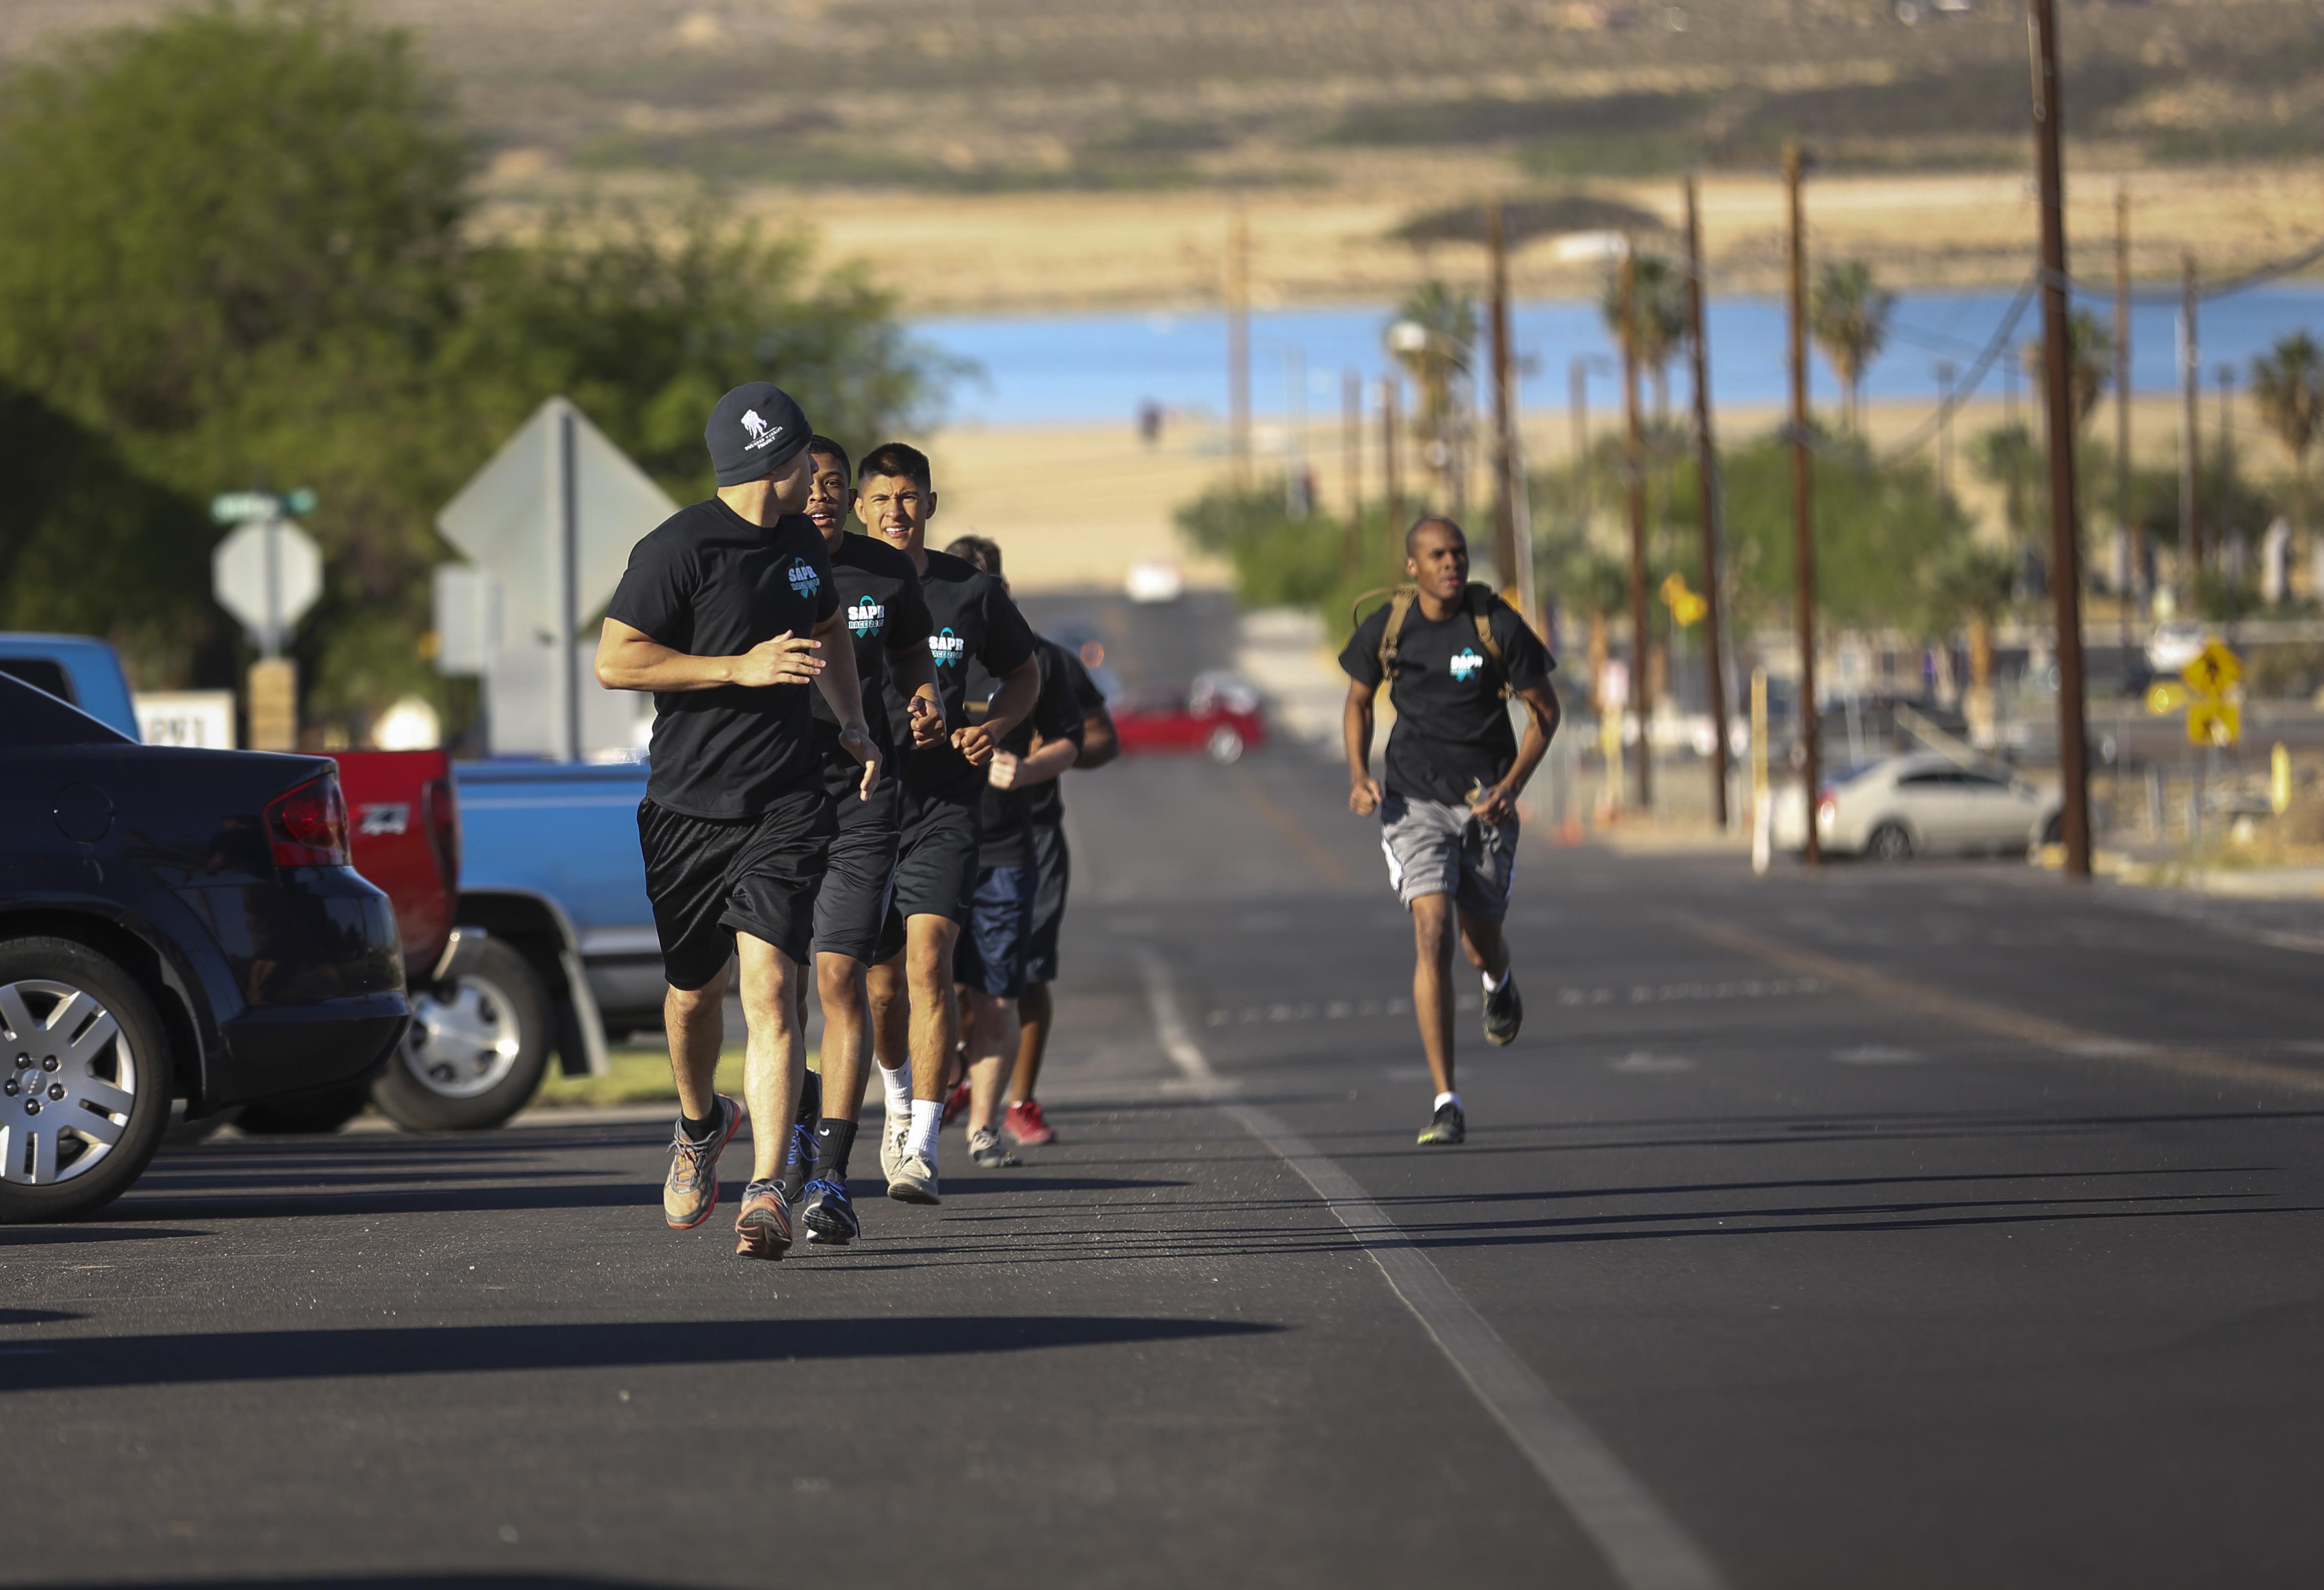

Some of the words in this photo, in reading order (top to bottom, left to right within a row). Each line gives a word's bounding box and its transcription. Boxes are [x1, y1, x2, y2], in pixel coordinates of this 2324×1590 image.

[788, 566, 817, 581] SAPR
[848, 605, 884, 620] SAPR
[849, 621, 868, 629] RACE
[929, 636, 964, 651] SAPR
[932, 650, 946, 658] ACE
